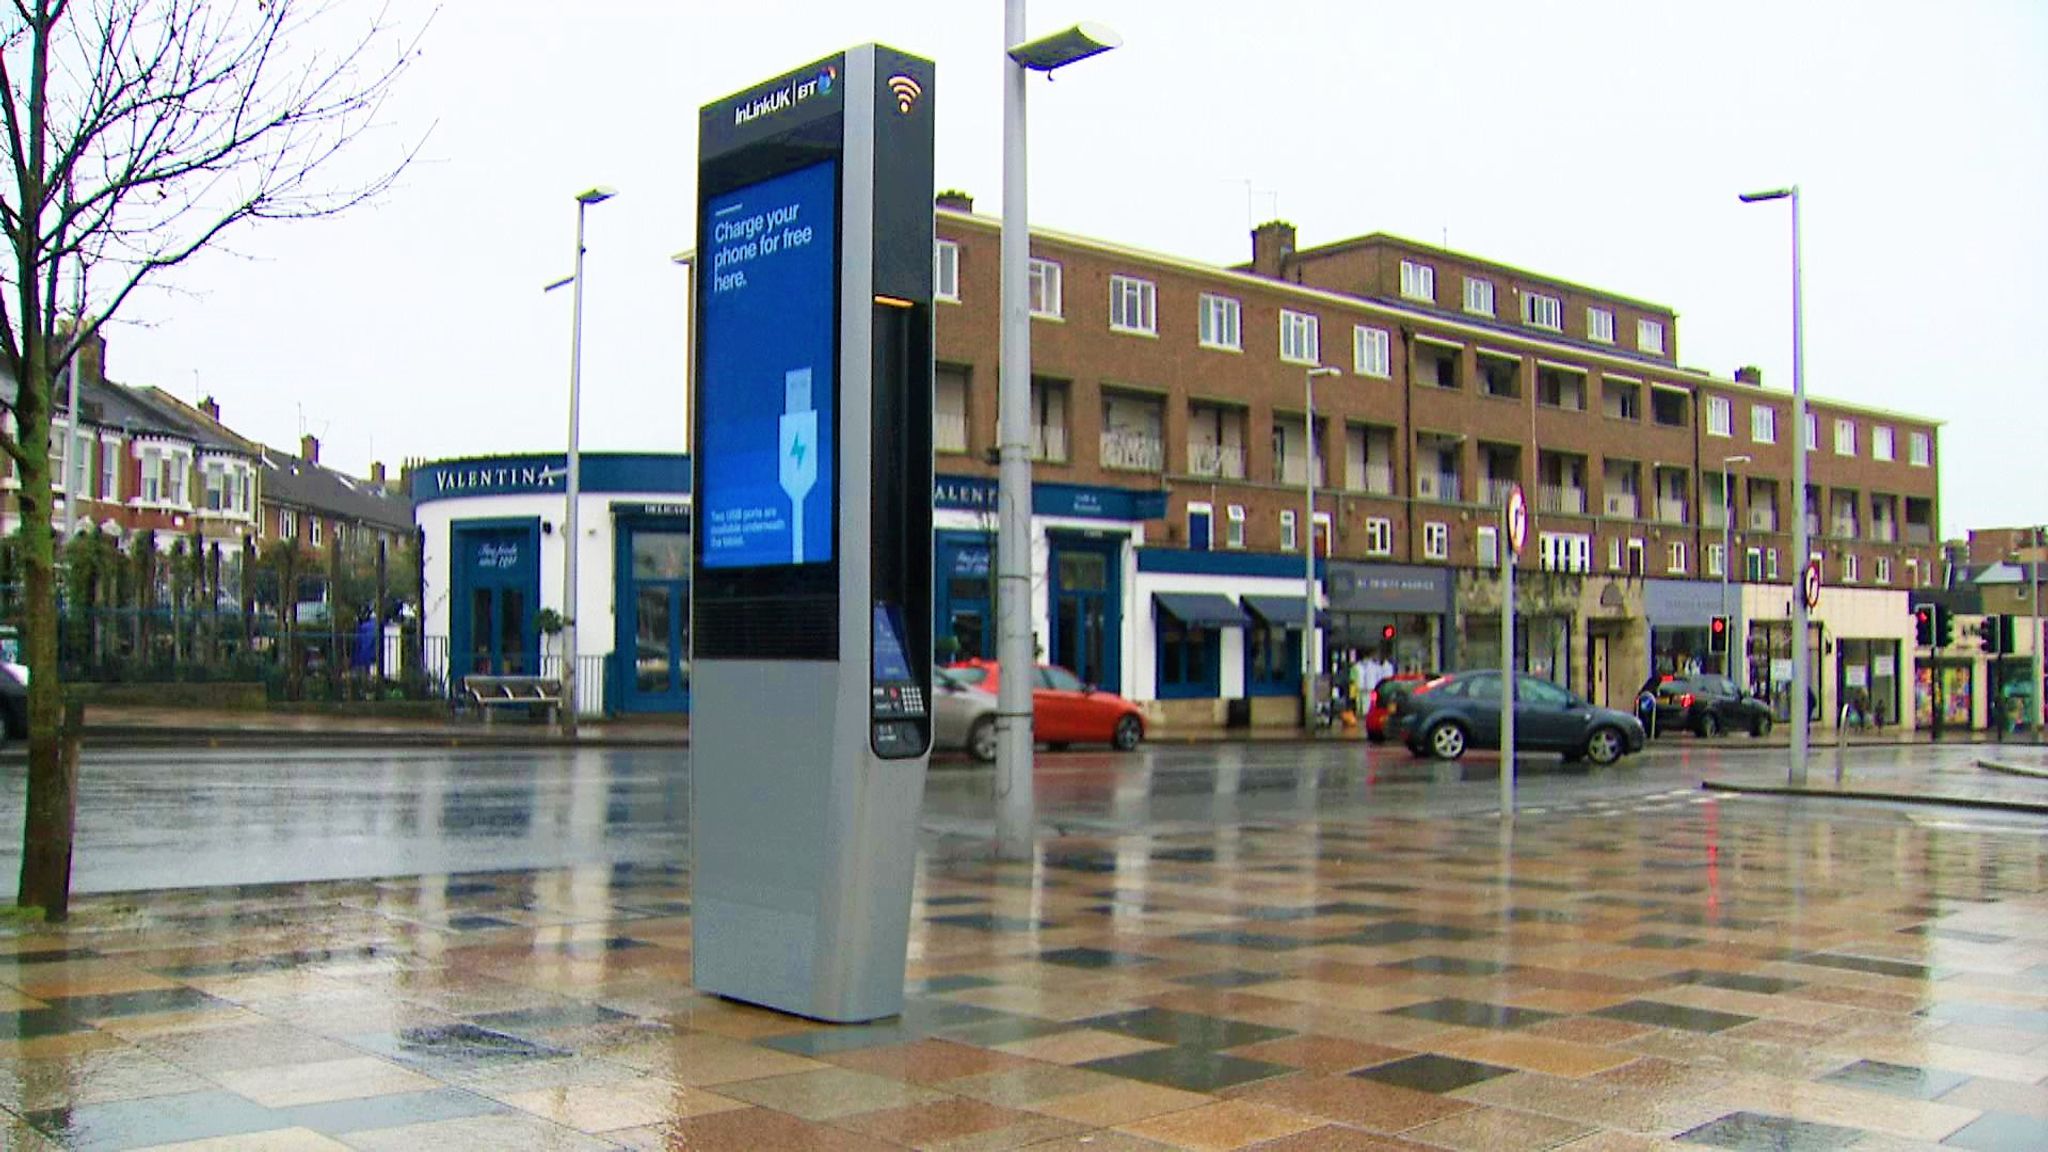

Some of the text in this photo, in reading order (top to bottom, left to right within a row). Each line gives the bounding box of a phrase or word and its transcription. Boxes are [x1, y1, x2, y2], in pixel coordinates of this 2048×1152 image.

[735, 80, 818, 126] InLinkUK BT
[715, 203, 799, 243] Charge your
[714, 226, 813, 273] phone for free
[714, 270, 747, 293] here.
[436, 464, 555, 491] VALENTINA
[934, 484, 998, 503] ALENT
